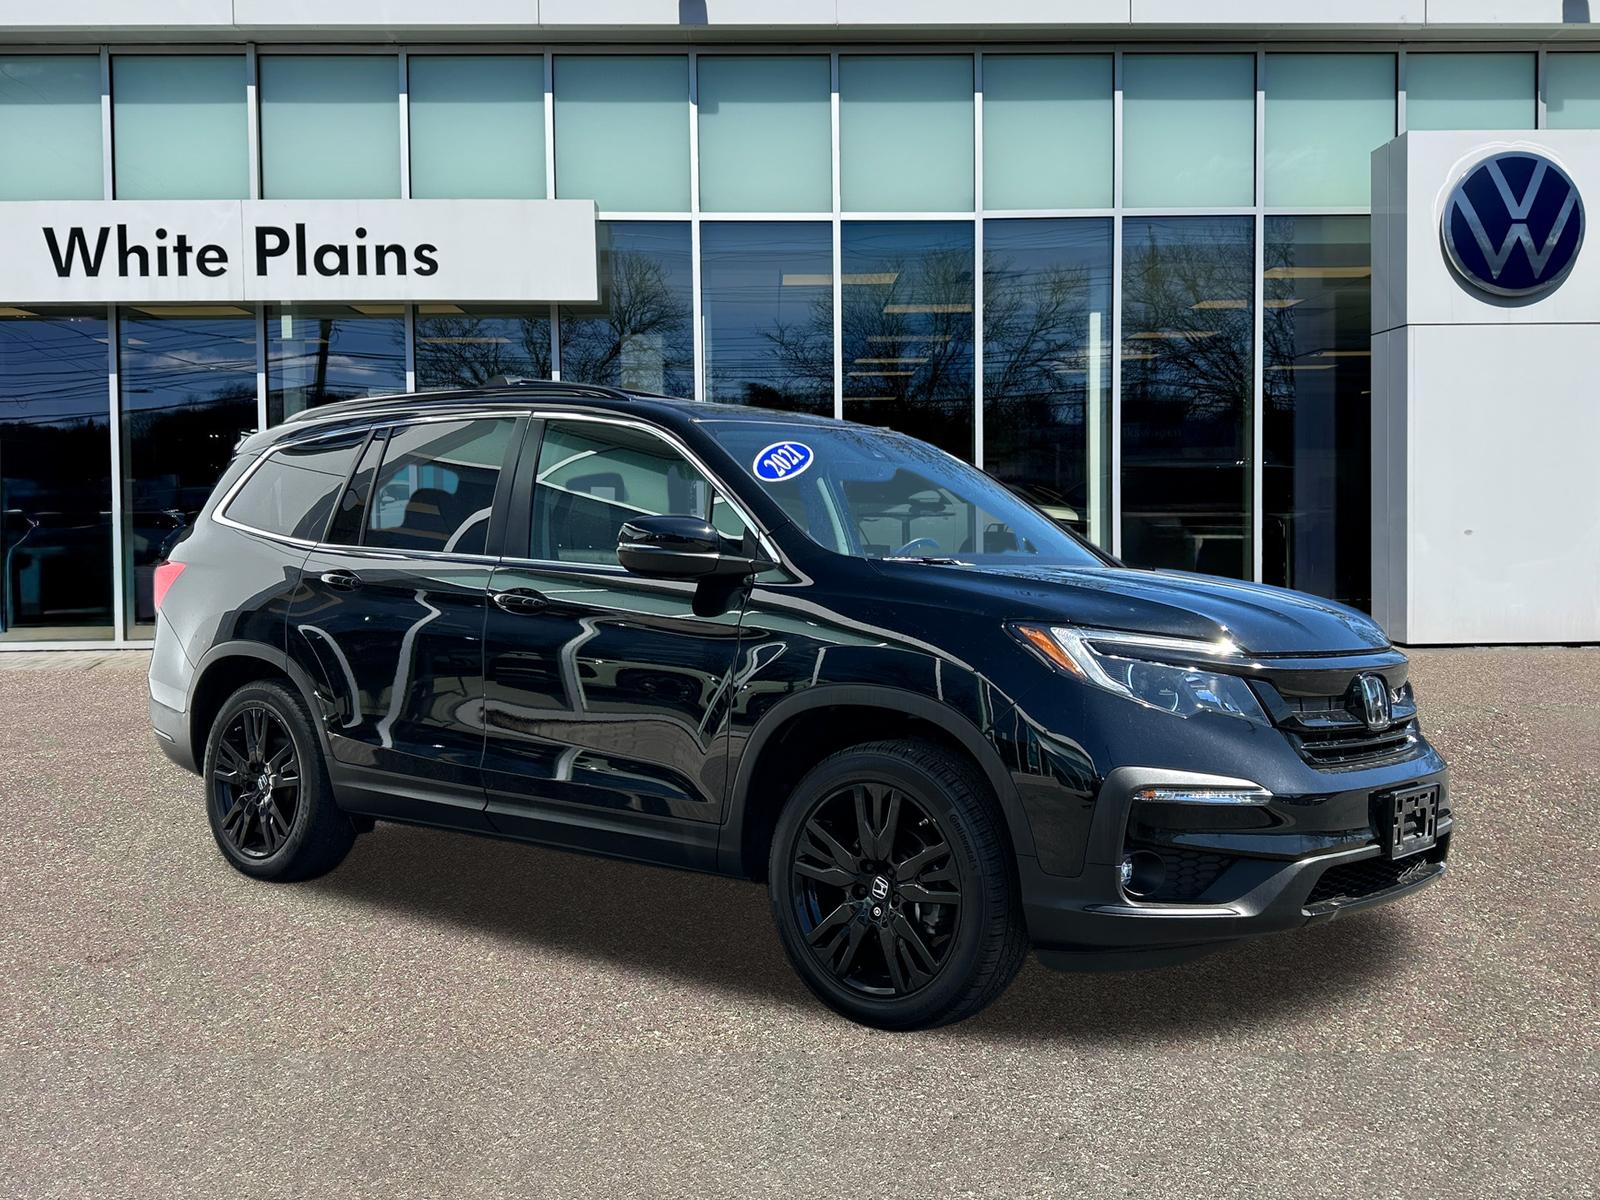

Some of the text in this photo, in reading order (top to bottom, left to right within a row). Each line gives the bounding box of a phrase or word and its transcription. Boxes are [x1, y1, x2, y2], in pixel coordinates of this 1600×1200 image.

[43, 223, 439, 277] White Plains
[763, 444, 805, 477] 2021
